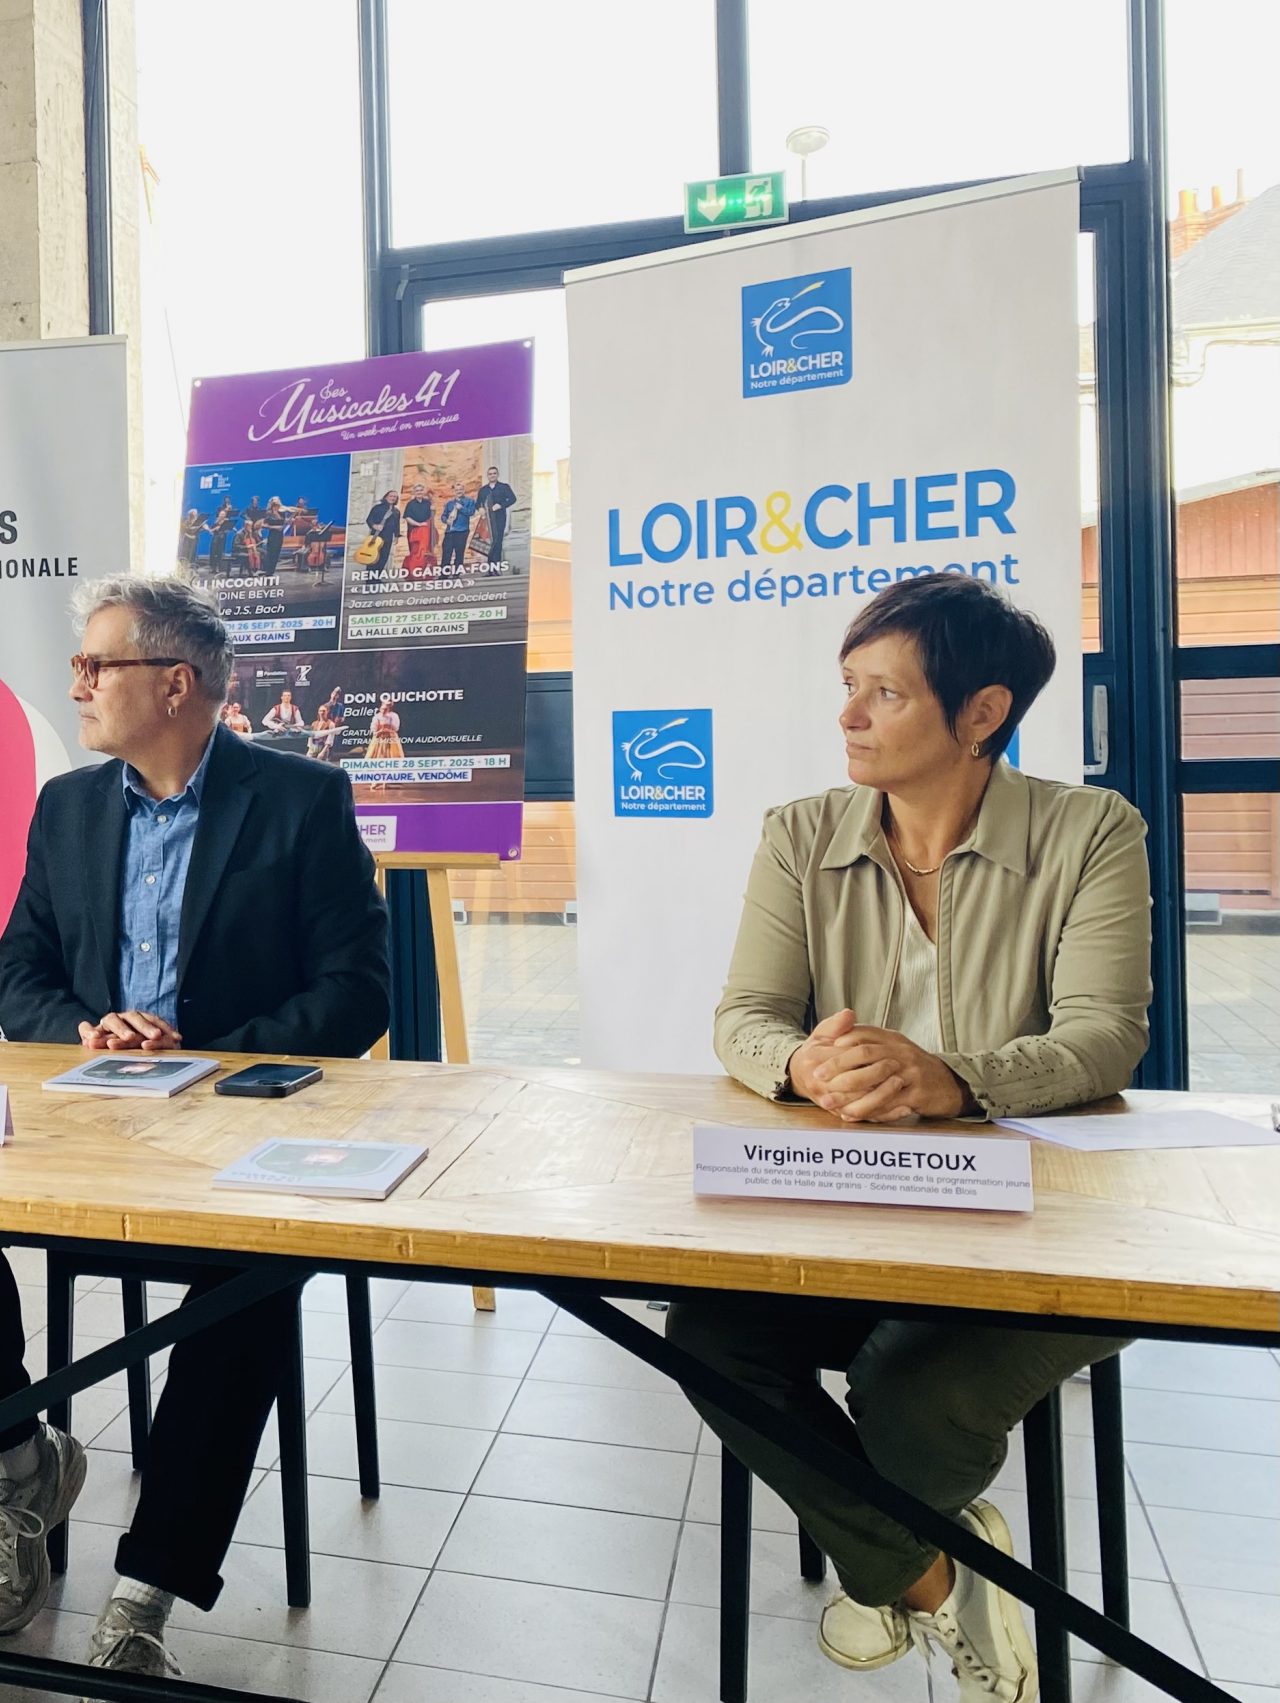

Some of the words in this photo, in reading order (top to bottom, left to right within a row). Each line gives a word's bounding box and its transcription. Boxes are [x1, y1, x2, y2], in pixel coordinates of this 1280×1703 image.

[750, 351, 843, 379] LOIR&CHER
[750, 379, 777, 390] Notre
[779, 369, 844, 386] département
[319, 379, 348, 401] Les
[248, 378, 413, 442] Musicales
[415, 368, 460, 407] 41
[414, 413, 460, 431] musique
[608, 468, 1017, 567] LOIR&CHER
[351, 568, 409, 581] RENAUD
[211, 576, 280, 589] INCOGNITI
[362, 581, 399, 594] LUNA
[403, 581, 422, 592] DE
[425, 579, 463, 591] SEDA
[248, 589, 284, 599] BEYER
[348, 599, 372, 609] Jazz
[375, 597, 404, 607] entre
[407, 595, 440, 606] Orient
[443, 595, 455, 603] et
[457, 591, 507, 603] Occident
[609, 577, 715, 611] Notre
[233, 605, 252, 616] J.S.
[255, 604, 285, 614] Bach
[351, 615, 393, 625] SAMEDI
[395, 613, 408, 623] 27
[410, 612, 440, 622] SEPT.
[444, 611, 469, 620] 2025
[479, 610, 492, 618] 20
[495, 609, 504, 617] H
[238, 622, 249, 631] 26
[251, 621, 277, 630] SEPT.
[281, 619, 303, 628] 2025
[312, 619, 323, 627] 20
[325, 618, 333, 626] H
[350, 628, 363, 637] LA
[366, 626, 398, 636] HALLE
[401, 625, 422, 635] AUX
[425, 623, 465, 633] GRAINS
[254, 632, 290, 641] GRAINS
[344, 692, 376, 704] DON
[380, 689, 464, 703] QUICHOTTE
[415, 734, 482, 744] AUDIOVISUELLE
[342, 759, 400, 769] DIMANCHE
[403, 758, 414, 767] 28
[417, 758, 446, 767] SEPT.
[449, 757, 474, 766] 2025
[484, 757, 495, 766] 18
[499, 757, 506, 765] H
[355, 772, 415, 782] MINOTAURE,
[417, 769, 468, 780] VENDÔME
[620, 785, 706, 801] LOIR&CHER
[621, 802, 646, 810] Notre
[647, 802, 706, 811] département
[744, 1144, 824, 1166] Virginie
[831, 1148, 977, 1171] POUGETOUX
[696, 1163, 748, 1174] Responsable
[751, 1167, 762, 1175] du
[764, 1167, 793, 1176] service
[796, 1169, 811, 1177] des
[813, 1170, 842, 1179] publics
[845, 1171, 853, 1179] et
[856, 1172, 911, 1182] coordinatrice
[913, 1174, 924, 1182] de
[926, 1175, 934, 1183] la
[936, 1176, 1003, 1187] programmation
[1005, 1180, 1031, 1189] jeune
[745, 1177, 769, 1186] public
[785, 1178, 792, 1186] la
[794, 1179, 816, 1187] Halle
[836, 1182, 862, 1190] grains
[870, 1183, 897, 1192] Scène
[900, 1184, 939, 1194] nationale
[941, 1187, 953, 1195] de
[955, 1187, 977, 1196] Blois
